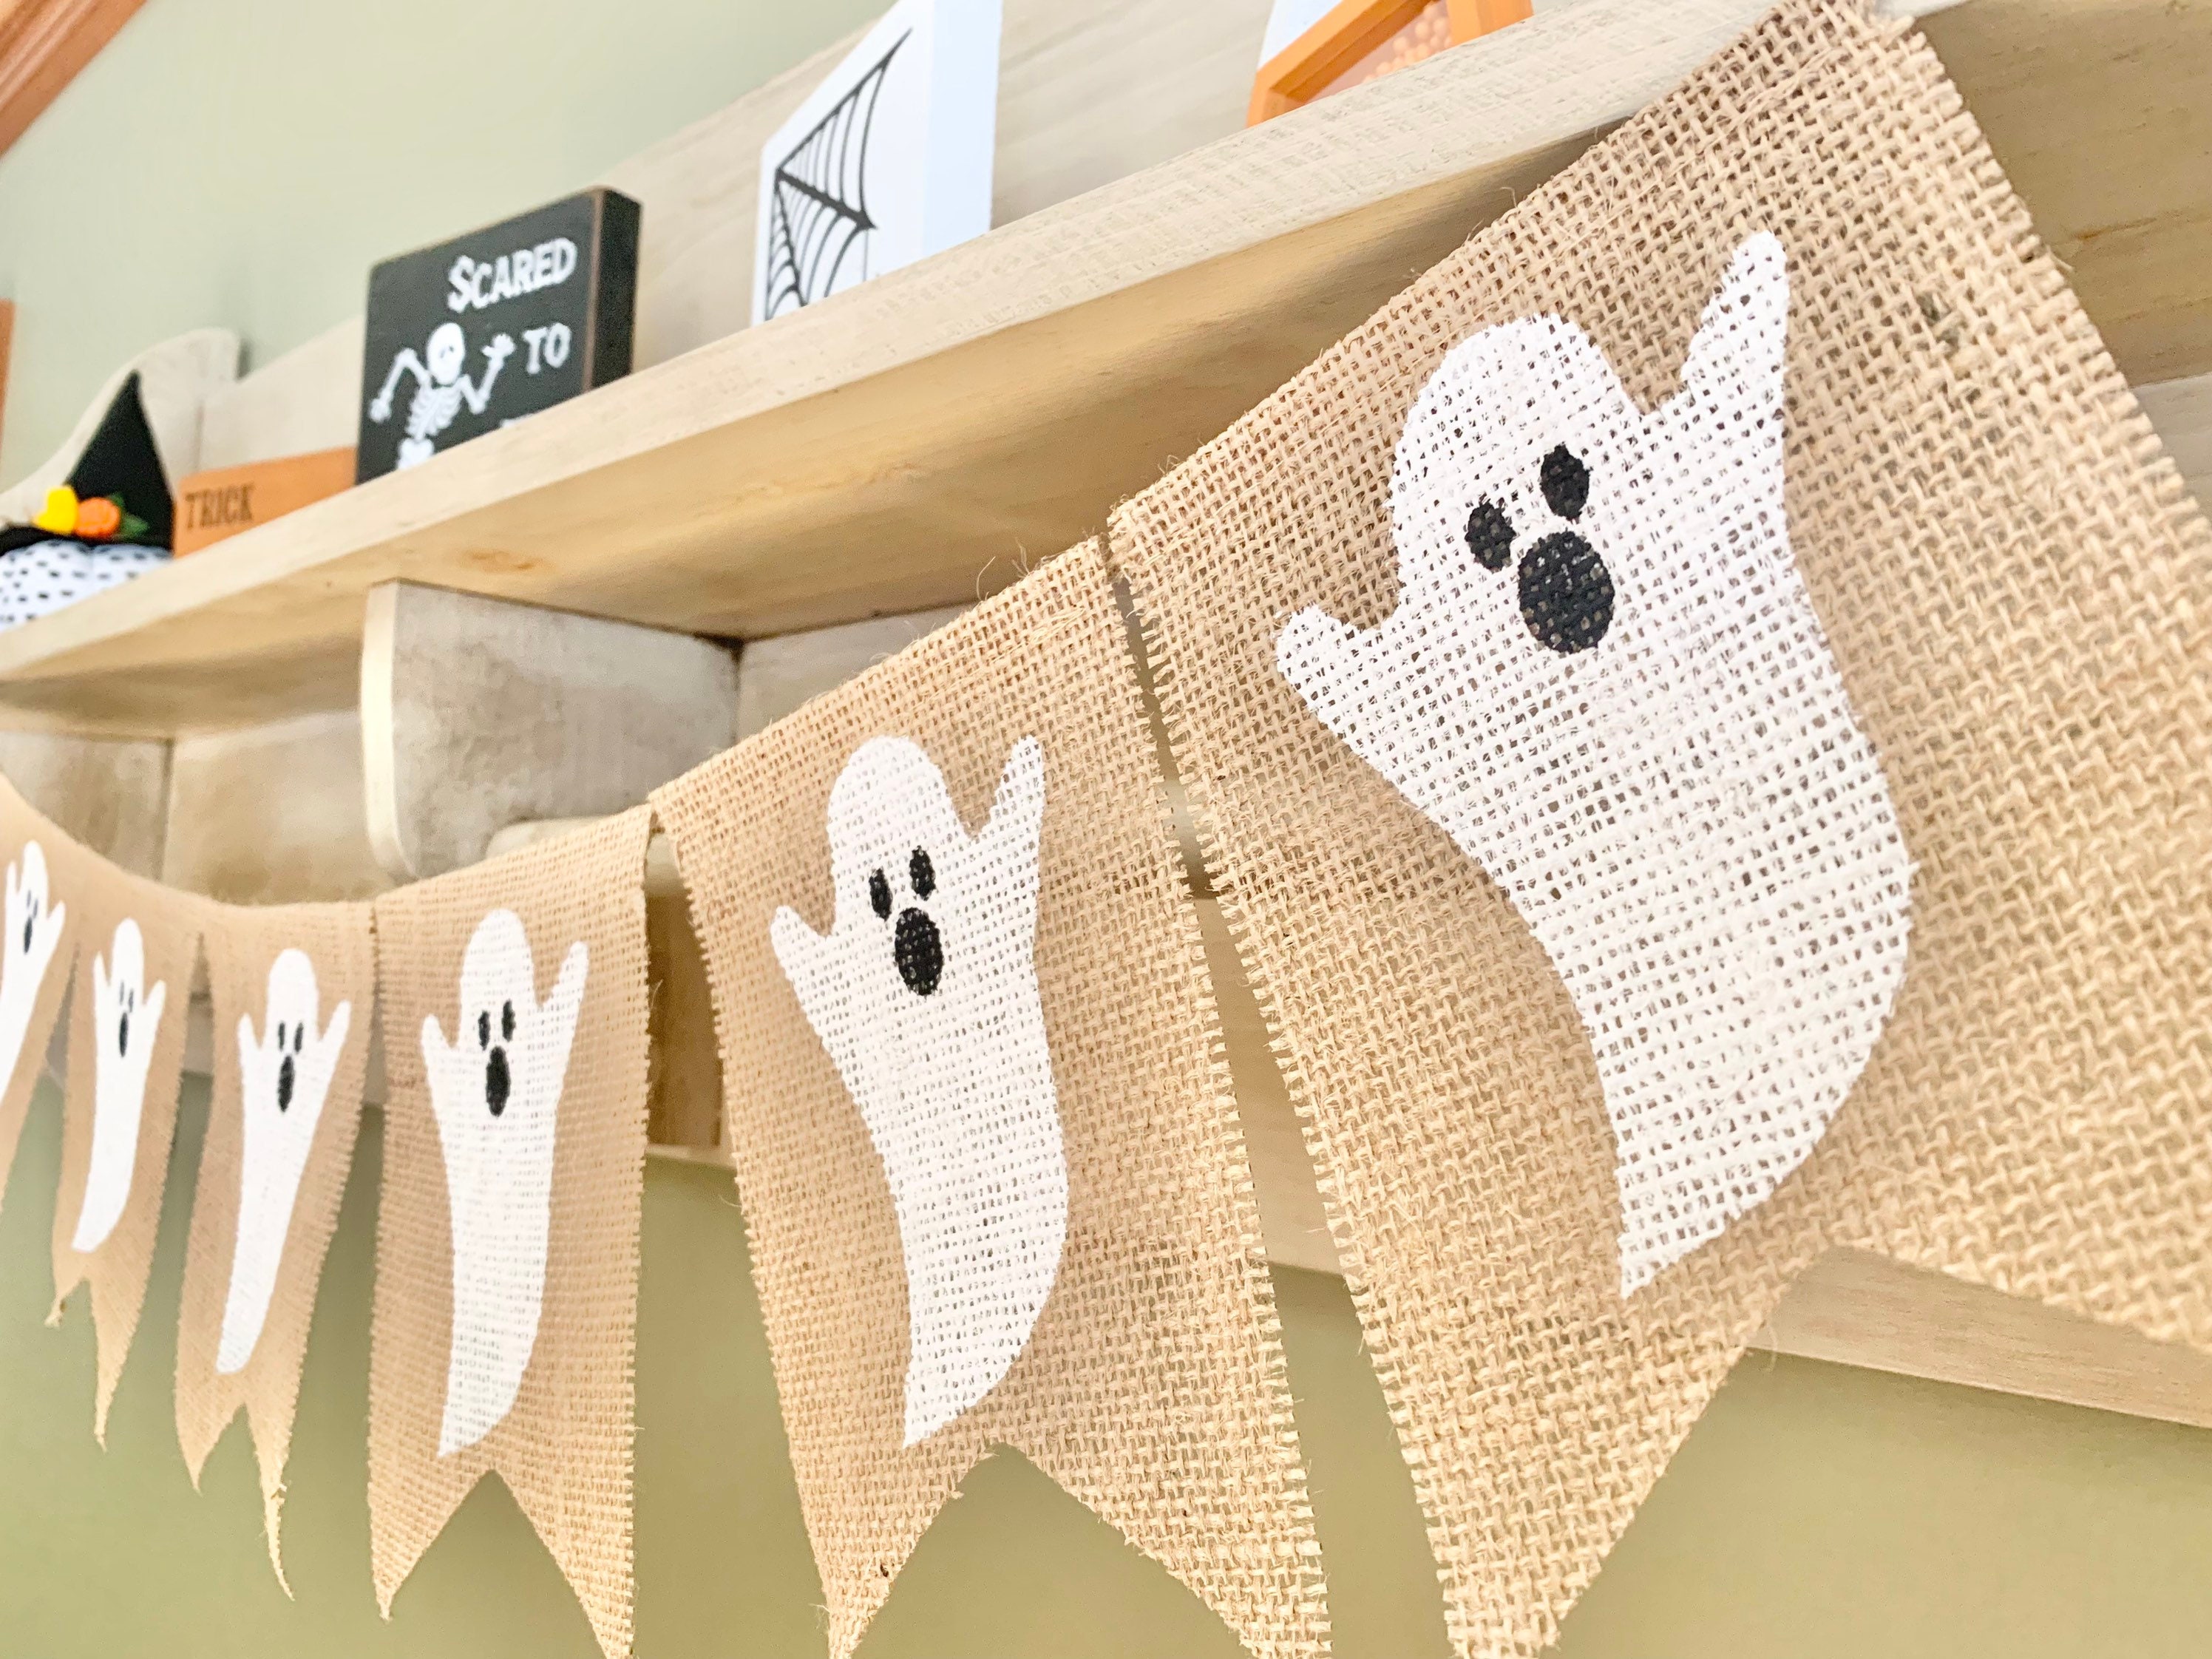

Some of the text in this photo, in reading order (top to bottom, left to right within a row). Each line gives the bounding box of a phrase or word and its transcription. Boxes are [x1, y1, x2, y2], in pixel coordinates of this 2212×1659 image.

[447, 237, 577, 313] SCARED
[523, 322, 571, 375] TO
[185, 482, 255, 530] TRICK
